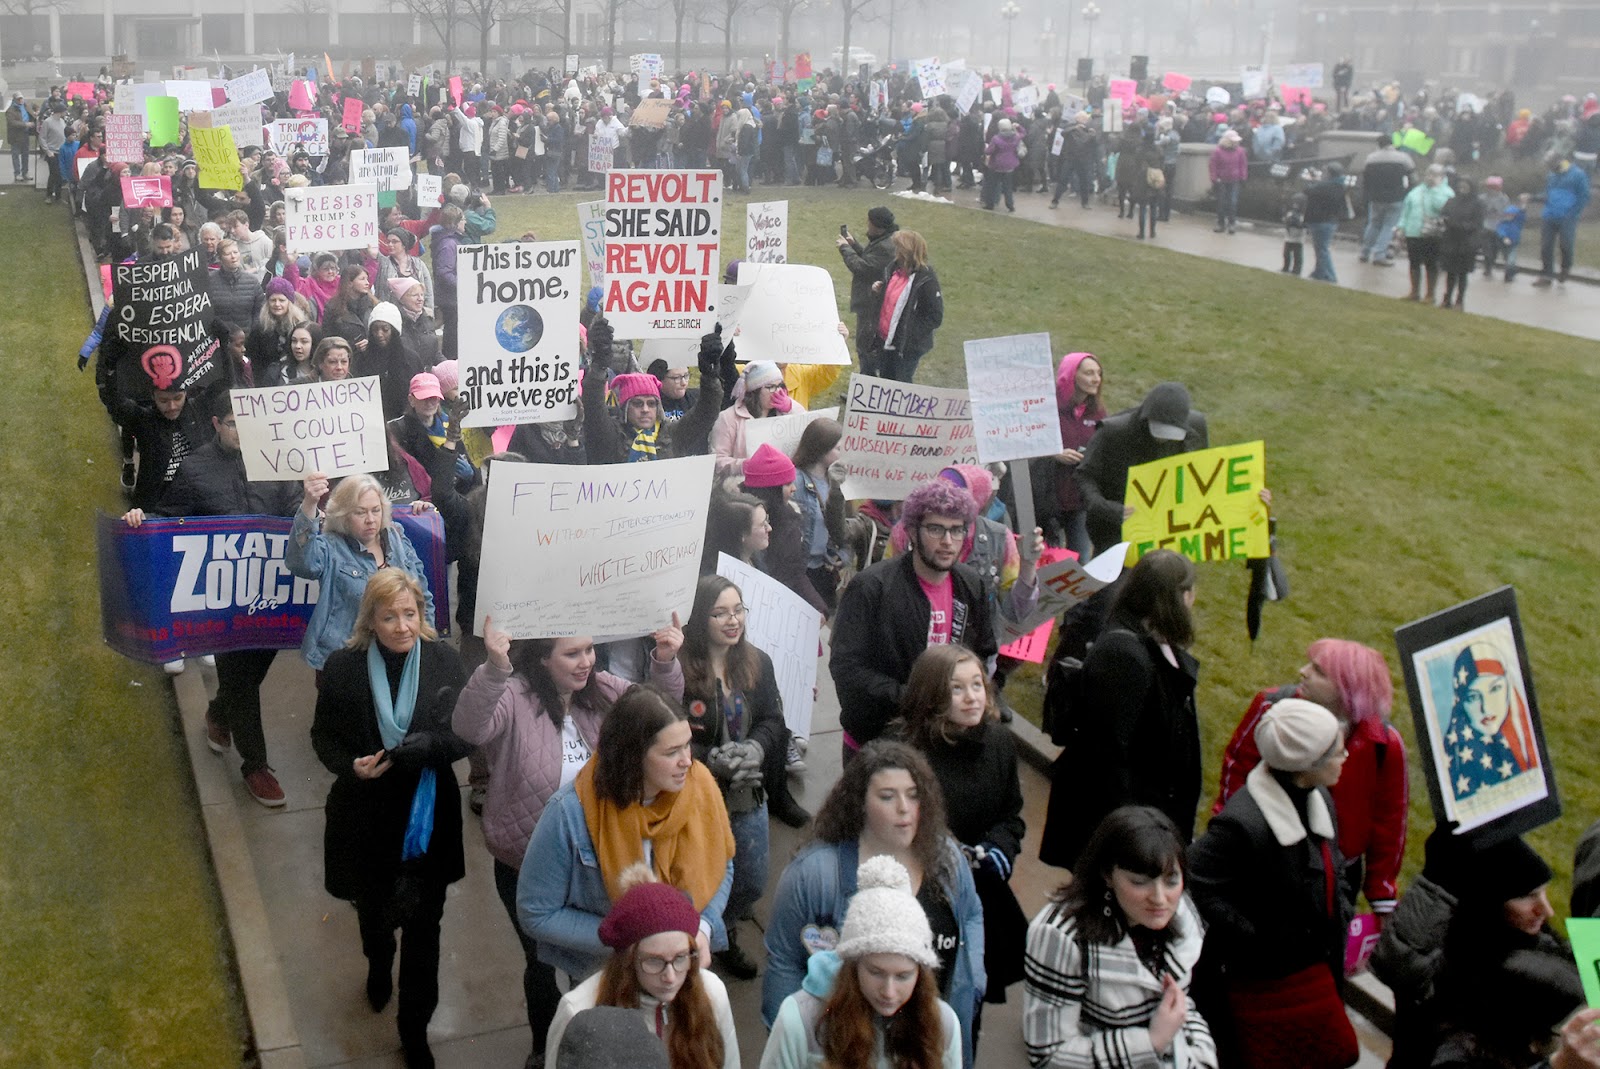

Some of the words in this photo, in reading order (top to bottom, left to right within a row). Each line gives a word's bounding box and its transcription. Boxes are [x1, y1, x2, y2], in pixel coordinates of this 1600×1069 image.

[210, 128, 227, 148] UP
[279, 122, 310, 133] TRUMP
[280, 133, 293, 143] DO
[296, 133, 319, 142] HAVE
[320, 134, 327, 142] A
[218, 147, 231, 164] UP
[275, 142, 327, 156] VOCE
[363, 149, 394, 164] Females
[358, 167, 371, 179] are
[372, 165, 399, 179] strong
[376, 177, 391, 192] hell
[608, 173, 719, 203] REVOLT.
[306, 193, 376, 212] RESIST
[304, 211, 356, 222] TRUMP'S
[605, 208, 651, 237] SHE
[654, 208, 718, 237] SAID.
[749, 212, 782, 231] Voice
[289, 222, 374, 240] FASCISM
[748, 235, 782, 251] Choice
[117, 260, 180, 285] RESPETA
[183, 251, 200, 273] MI
[515, 245, 532, 269] is
[536, 248, 577, 269] our
[605, 243, 718, 275] REVOLT
[131, 279, 194, 302] EXISTENCIA
[476, 272, 569, 304] home,
[604, 280, 715, 312] AGAIN.
[120, 304, 136, 322] O
[148, 291, 212, 326] ESPERA
[117, 320, 207, 344] RESISTENCIA
[678, 318, 701, 329] BIRCH
[465, 359, 503, 387] and
[508, 356, 550, 384] this
[553, 355, 570, 382] is
[233, 393, 267, 418] I'M
[271, 390, 300, 414] SO
[305, 379, 376, 411] ANGRY
[459, 386, 483, 411] all
[850, 383, 939, 418] REMEMBER
[1022, 397, 1046, 413] your
[268, 422, 285, 442] I
[293, 412, 365, 440] COULD
[847, 415, 870, 431] WE
[877, 420, 906, 436] WILL
[916, 423, 942, 437] NOT
[949, 424, 974, 441] HOL
[985, 427, 1000, 436] not
[1004, 425, 1022, 439] just
[1025, 423, 1047, 437] your
[844, 435, 908, 456] OURSELVES
[910, 444, 944, 457] BOUND
[847, 464, 880, 479] HICH
[885, 469, 905, 481] WE
[910, 470, 941, 481] HAV
[1132, 455, 1254, 509] VIVE
[512, 479, 668, 516] FEMINISM
[1167, 504, 1222, 534] LA
[212, 532, 290, 560] KAT
[536, 527, 600, 546] WITHOUT
[579, 555, 638, 588] WHITE
[640, 538, 700, 573] SUPREMACY
[247, 593, 279, 616] for
[493, 599, 540, 611] SUPPORT
[172, 619, 226, 637] State
[563, 751, 592, 763] FEMA
